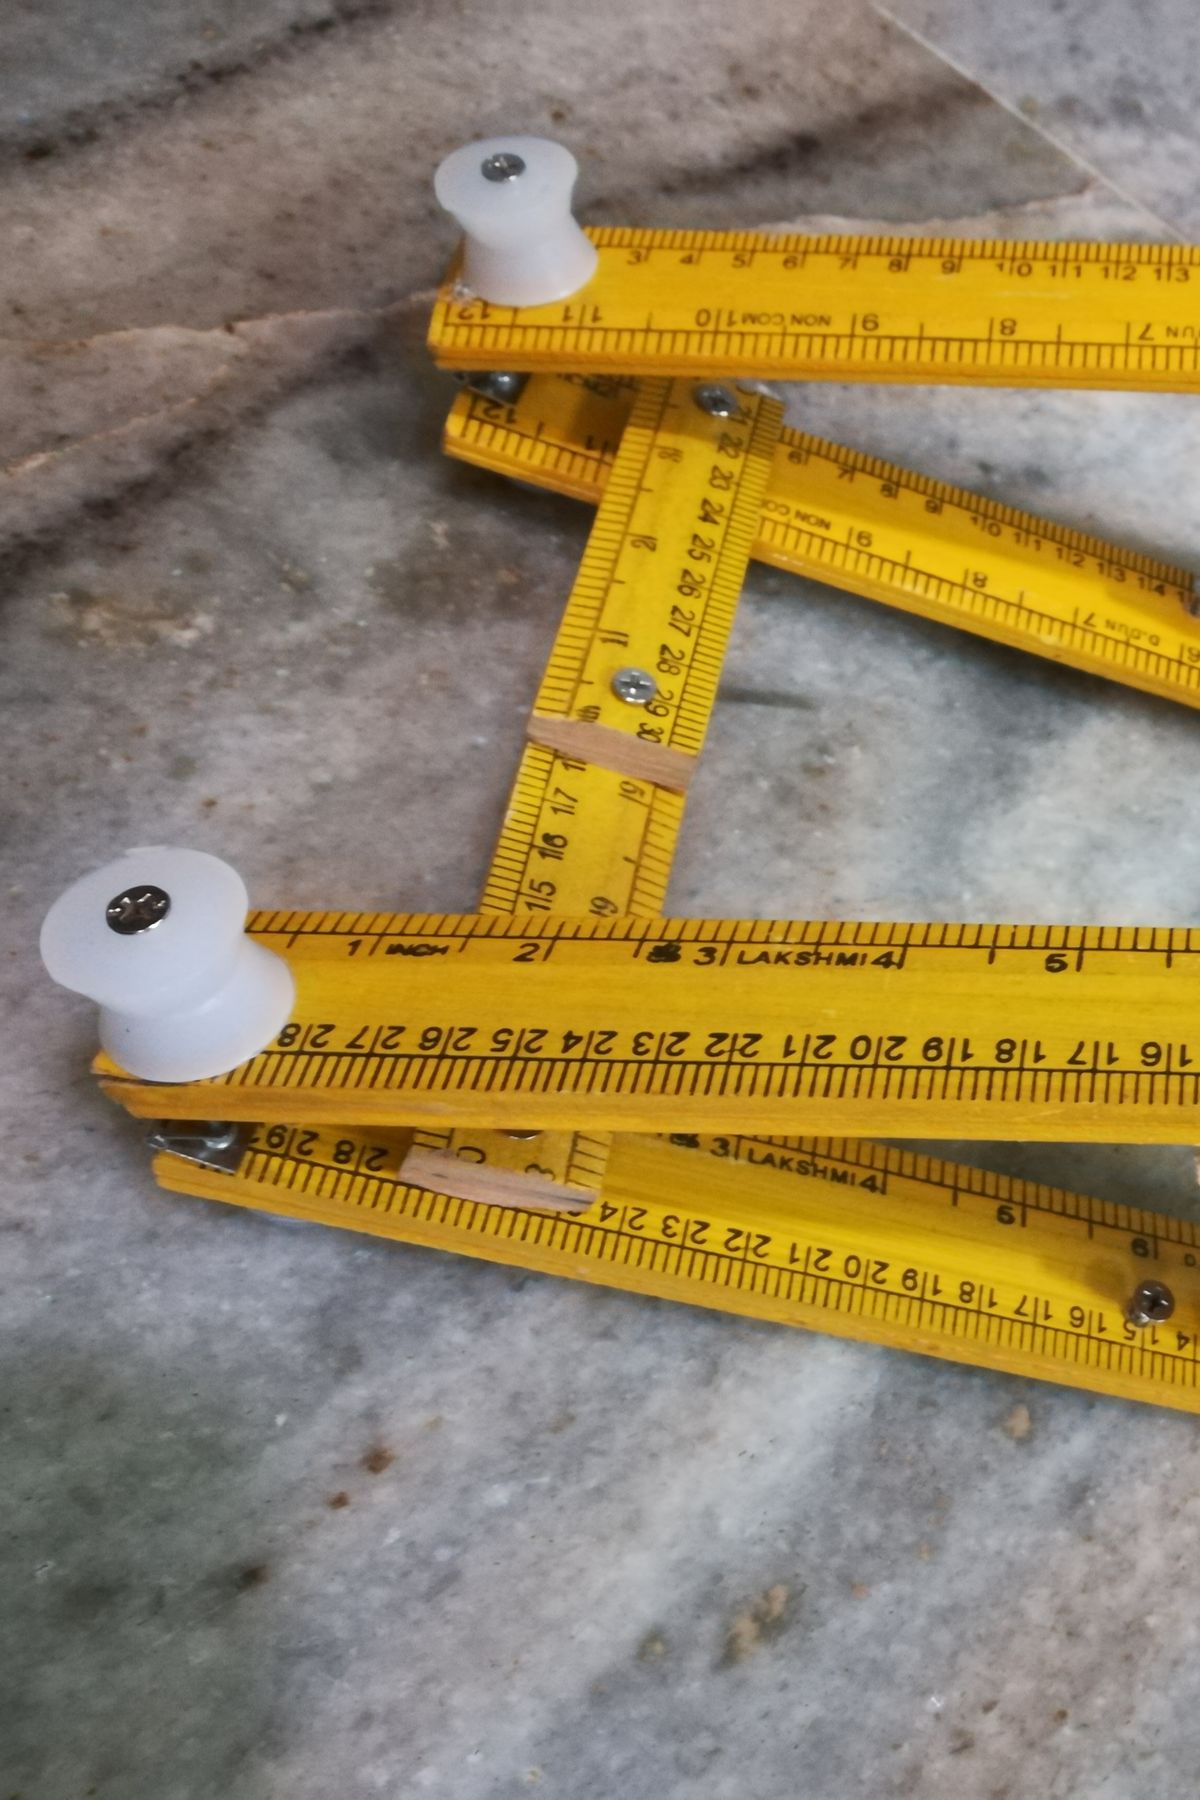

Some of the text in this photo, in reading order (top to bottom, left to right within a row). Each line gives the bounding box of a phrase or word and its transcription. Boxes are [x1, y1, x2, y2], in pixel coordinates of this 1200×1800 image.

[627, 250, 642, 266] 3
[679, 252, 695, 265] 4
[732, 254, 747, 268] 5
[783, 255, 798, 269] 6
[840, 256, 855, 270] 7
[889, 258, 904, 272] 8
[942, 260, 957, 274] 9
[997, 262, 1033, 277] 10
[1049, 264, 1082, 278] 11
[1101, 265, 1136, 281] 12
[1154, 267, 1189, 282] 13
[720, 432, 741, 459] 22
[709, 465, 734, 492] 23
[698, 498, 724, 525] 24
[688, 533, 715, 564] 25
[677, 569, 706, 599] 26
[668, 605, 695, 637] 27
[656, 643, 685, 676] 28
[550, 787, 578, 815] 17
[538, 833, 567, 860] 16
[525, 879, 556, 911] 15
[348, 940, 361, 956] 1
[513, 943, 540, 961] 2
[694, 947, 716, 965] 3
[737, 951, 867, 966] LAKSHMI
[872, 951, 894, 968] 4
[1045, 954, 1068, 972] 5
[277, 1023, 335, 1048] 28
[346, 1025, 406, 1050] 27
[418, 1026, 477, 1051] 26
[491, 1028, 548, 1054] 25
[562, 1030, 618, 1055] 24
[632, 1031, 690, 1057] 23
[705, 1032, 763, 1058] 22
[783, 1034, 837, 1059] 21
[850, 1035, 907, 1061] 20
[922, 1037, 974, 1062] 19
[995, 1038, 1046, 1063] 18
[1067, 1041, 1119, 1065] 17
[1141, 1042, 1193, 1067] 16
[266, 1125, 320, 1156] 29
[332, 1140, 388, 1171] 28
[710, 1137, 729, 1157] 3
[748, 1147, 855, 1186] LAKSHMI
[859, 1174, 878, 1194] 4
[996, 1205, 1015, 1225] 5
[1131, 1238, 1149, 1258] 6
[599, 1201, 648, 1231] 24
[661, 1215, 710, 1244] 23
[724, 1228, 772, 1258] 22
[788, 1242, 833, 1271] 21
[844, 1255, 890, 1284] 20
[901, 1268, 943, 1296] 19
[959, 1281, 998, 1309] 18
[1014, 1295, 1052, 1320] 17
[1070, 1306, 1107, 1333] 16
